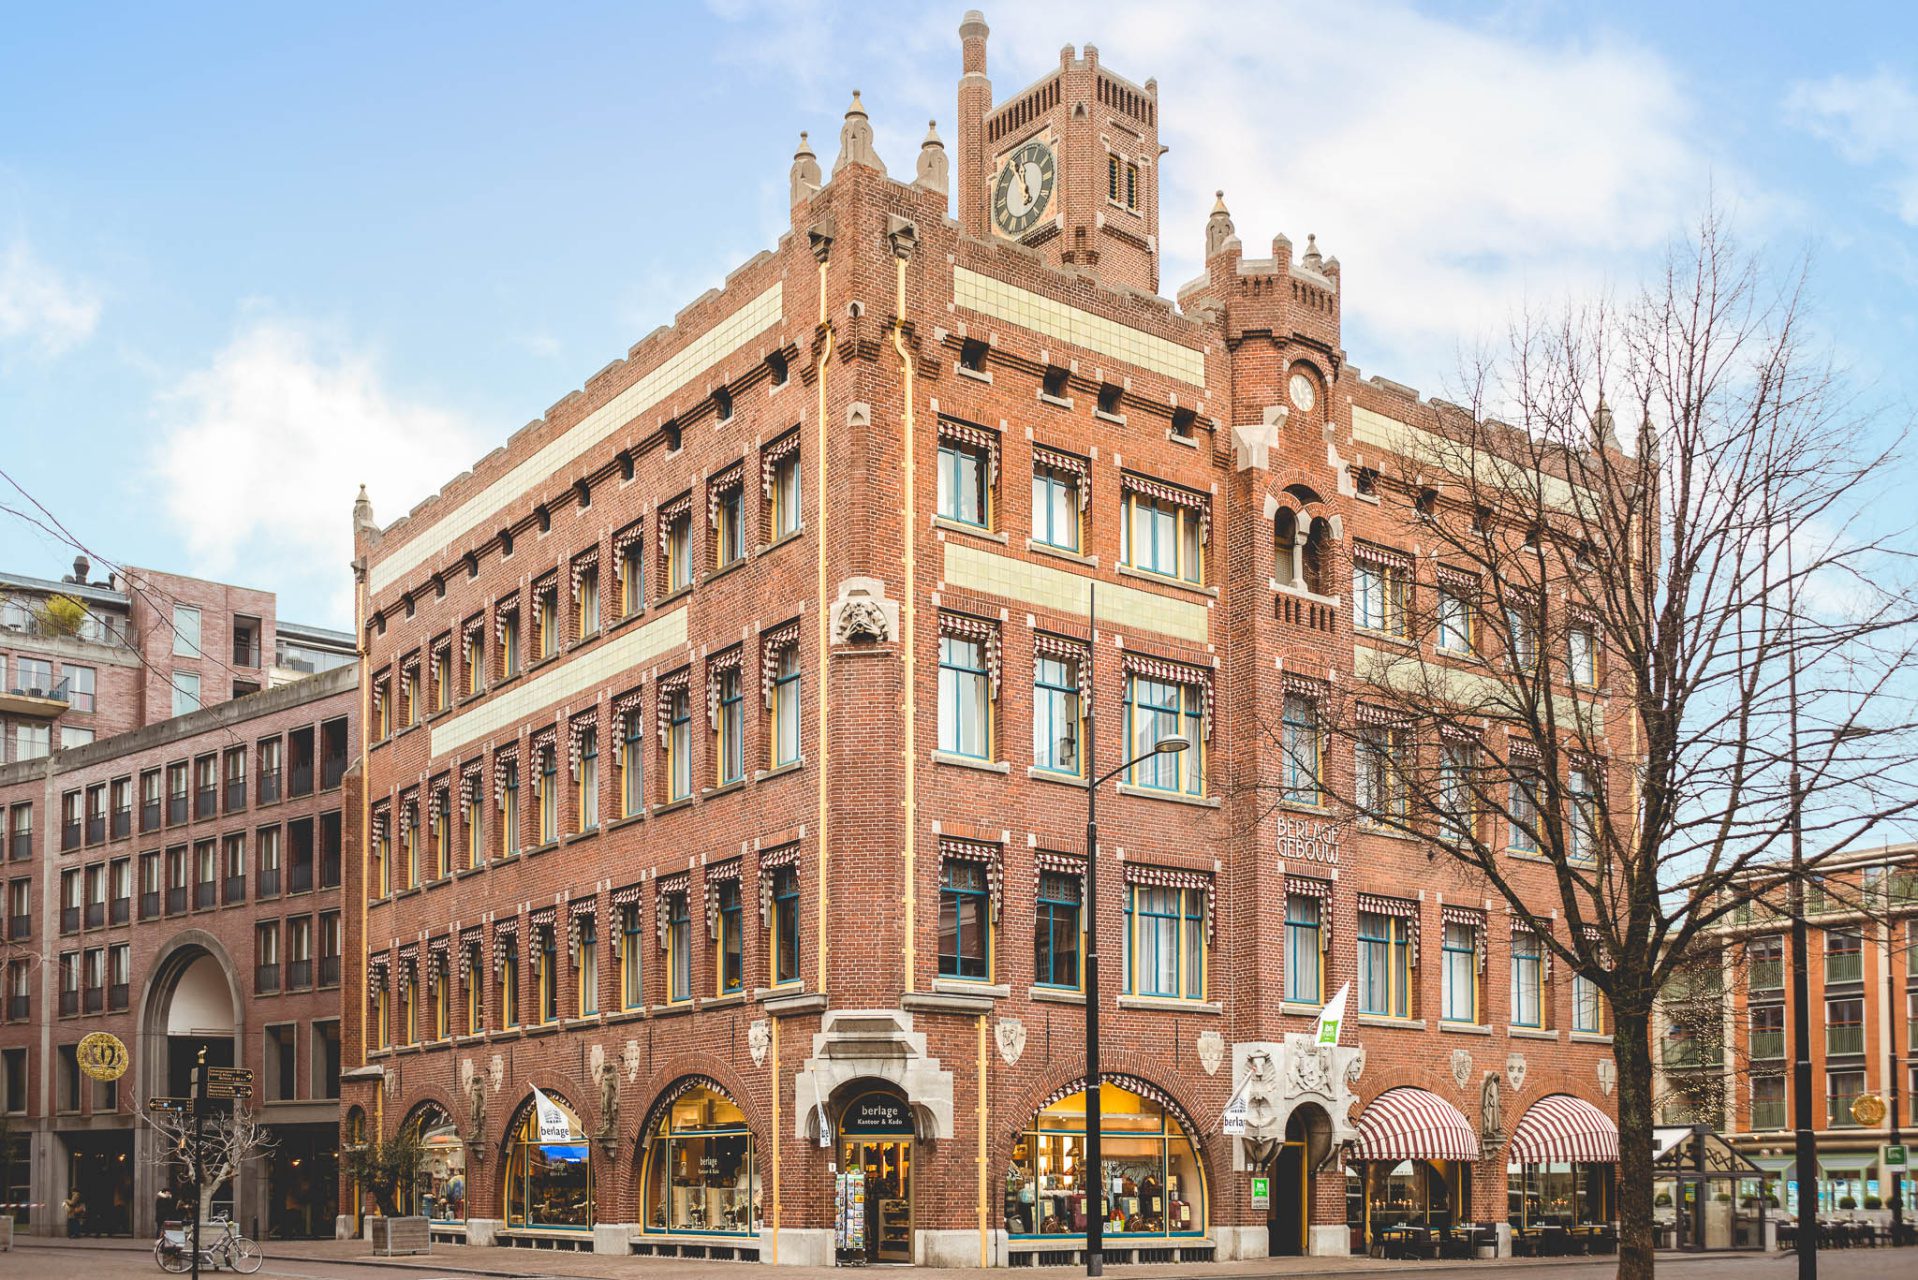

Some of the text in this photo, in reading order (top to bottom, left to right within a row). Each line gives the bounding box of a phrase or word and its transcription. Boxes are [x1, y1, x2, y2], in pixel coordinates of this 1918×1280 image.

[1277, 817, 1339, 845] BERLAGE
[1277, 837, 1339, 864] GEBOUW
[861, 1105, 898, 1118] berlage
[540, 1126, 569, 1138] berlage
